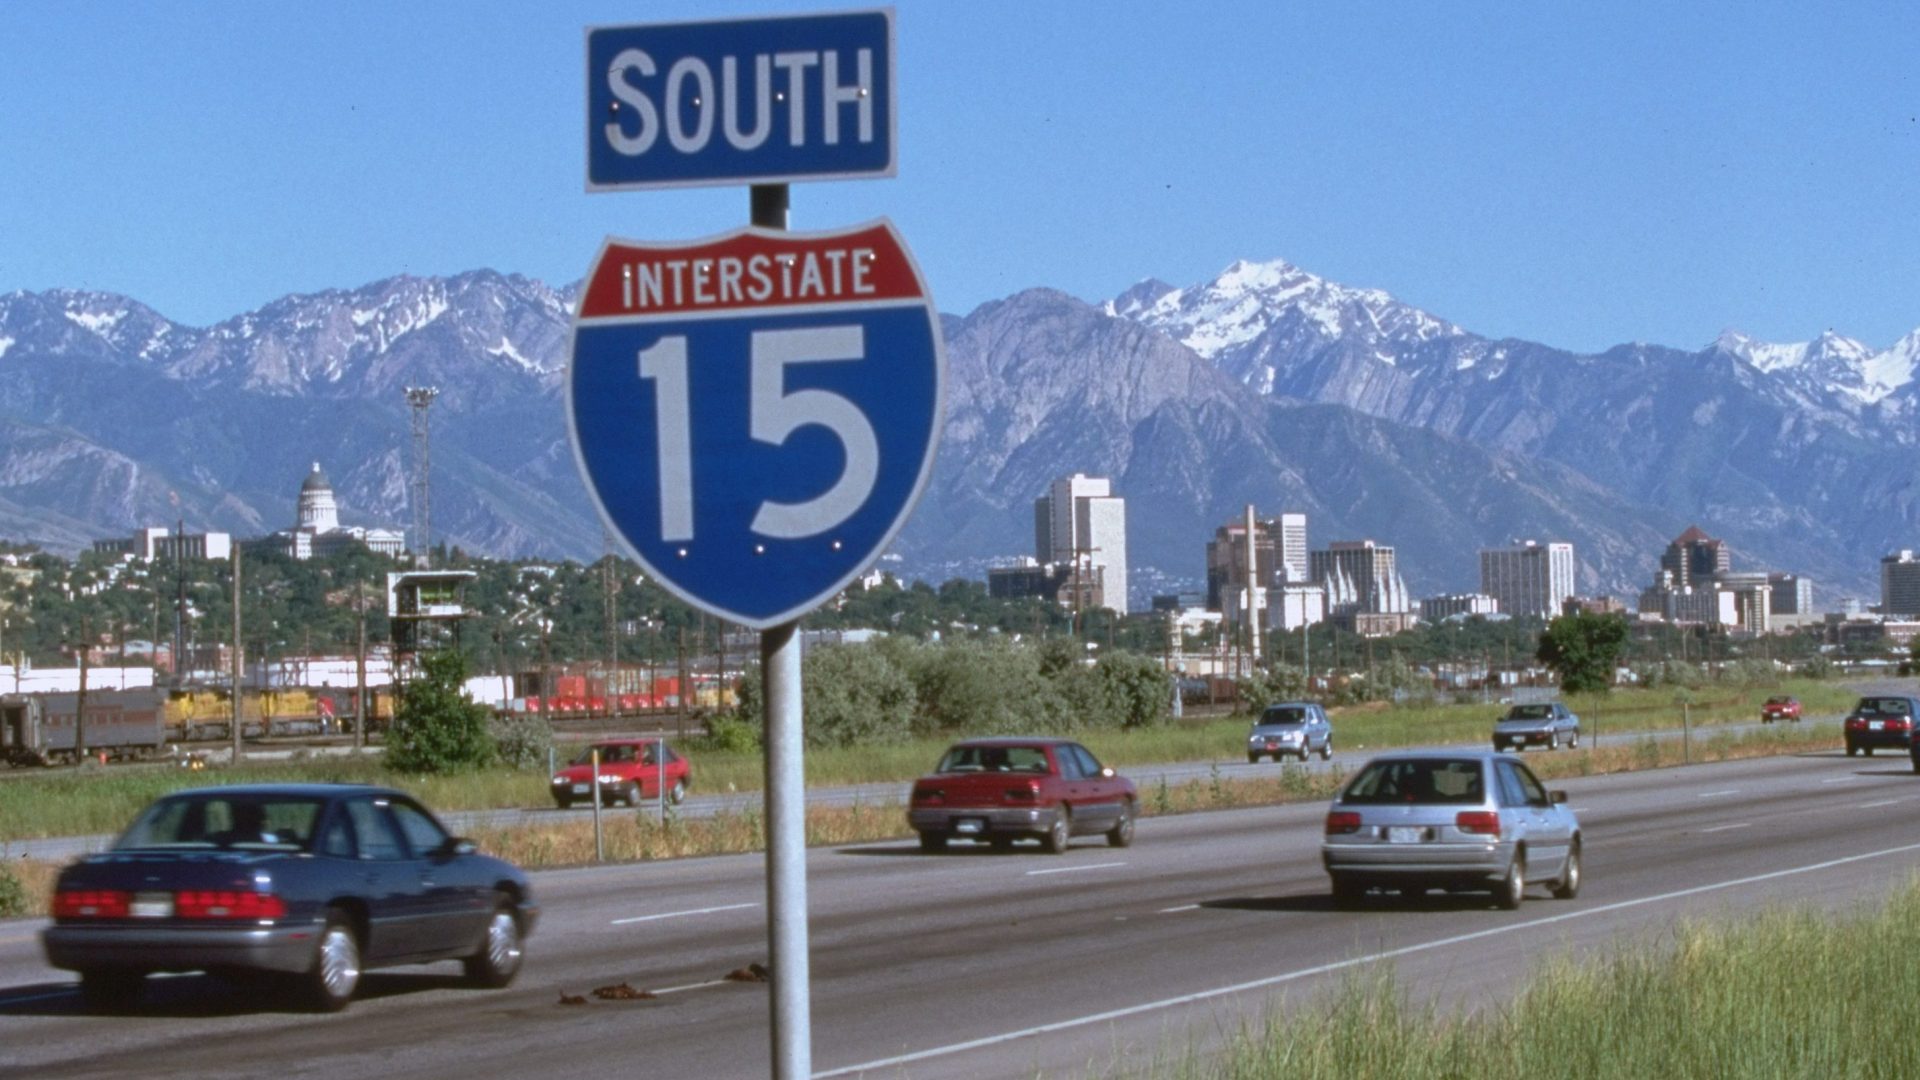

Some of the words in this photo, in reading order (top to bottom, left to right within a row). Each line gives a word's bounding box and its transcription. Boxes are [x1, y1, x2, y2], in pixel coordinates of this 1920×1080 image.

[605, 48, 873, 156] SOUTH
[623, 249, 875, 308] INTERSTATE
[638, 325, 879, 541] 15
